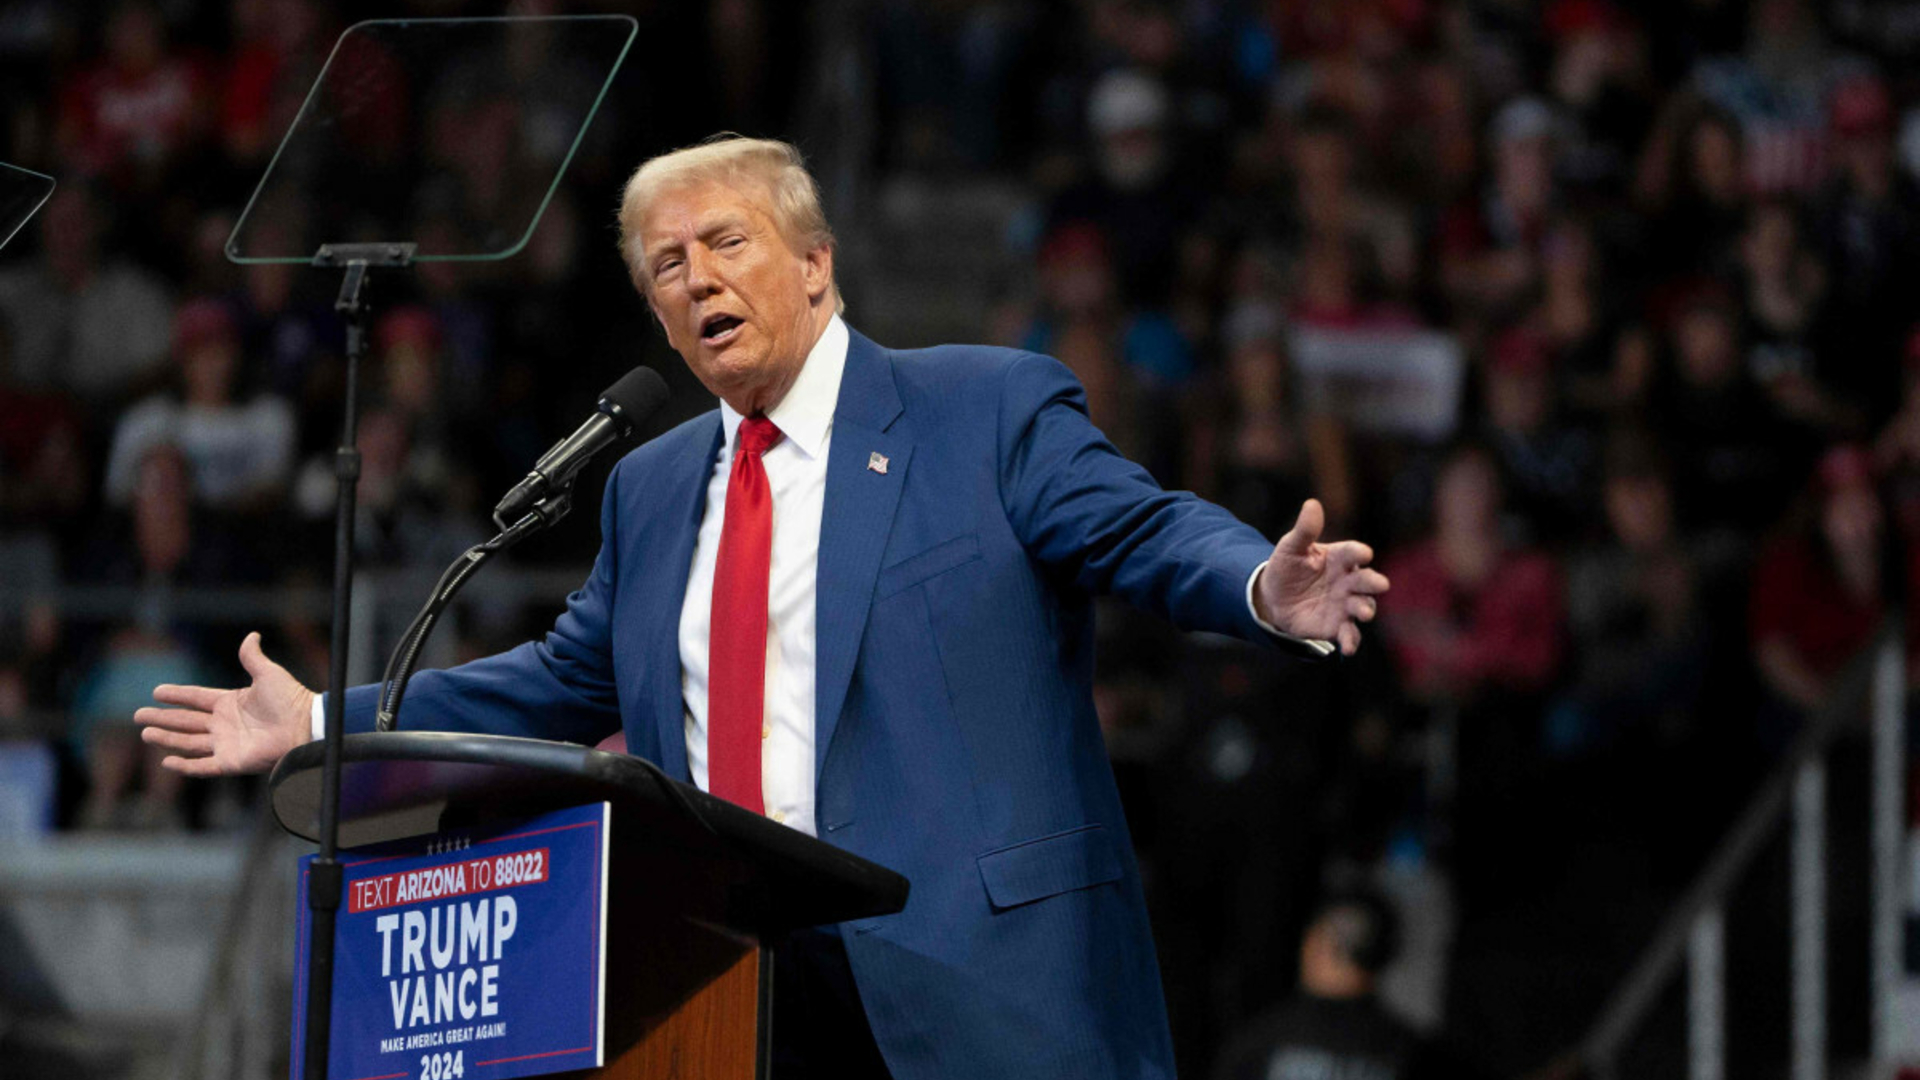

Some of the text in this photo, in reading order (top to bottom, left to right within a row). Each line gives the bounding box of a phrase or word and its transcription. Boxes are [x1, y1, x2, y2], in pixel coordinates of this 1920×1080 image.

[356, 851, 543, 909] TEXT ARIZONA TO 88022
[376, 895, 518, 977] TRUMP
[390, 965, 499, 1030] VANCE
[380, 1022, 506, 1053] MAKE AMERICA GREAT AGAIN!
[420, 1050, 464, 1080] 2024
